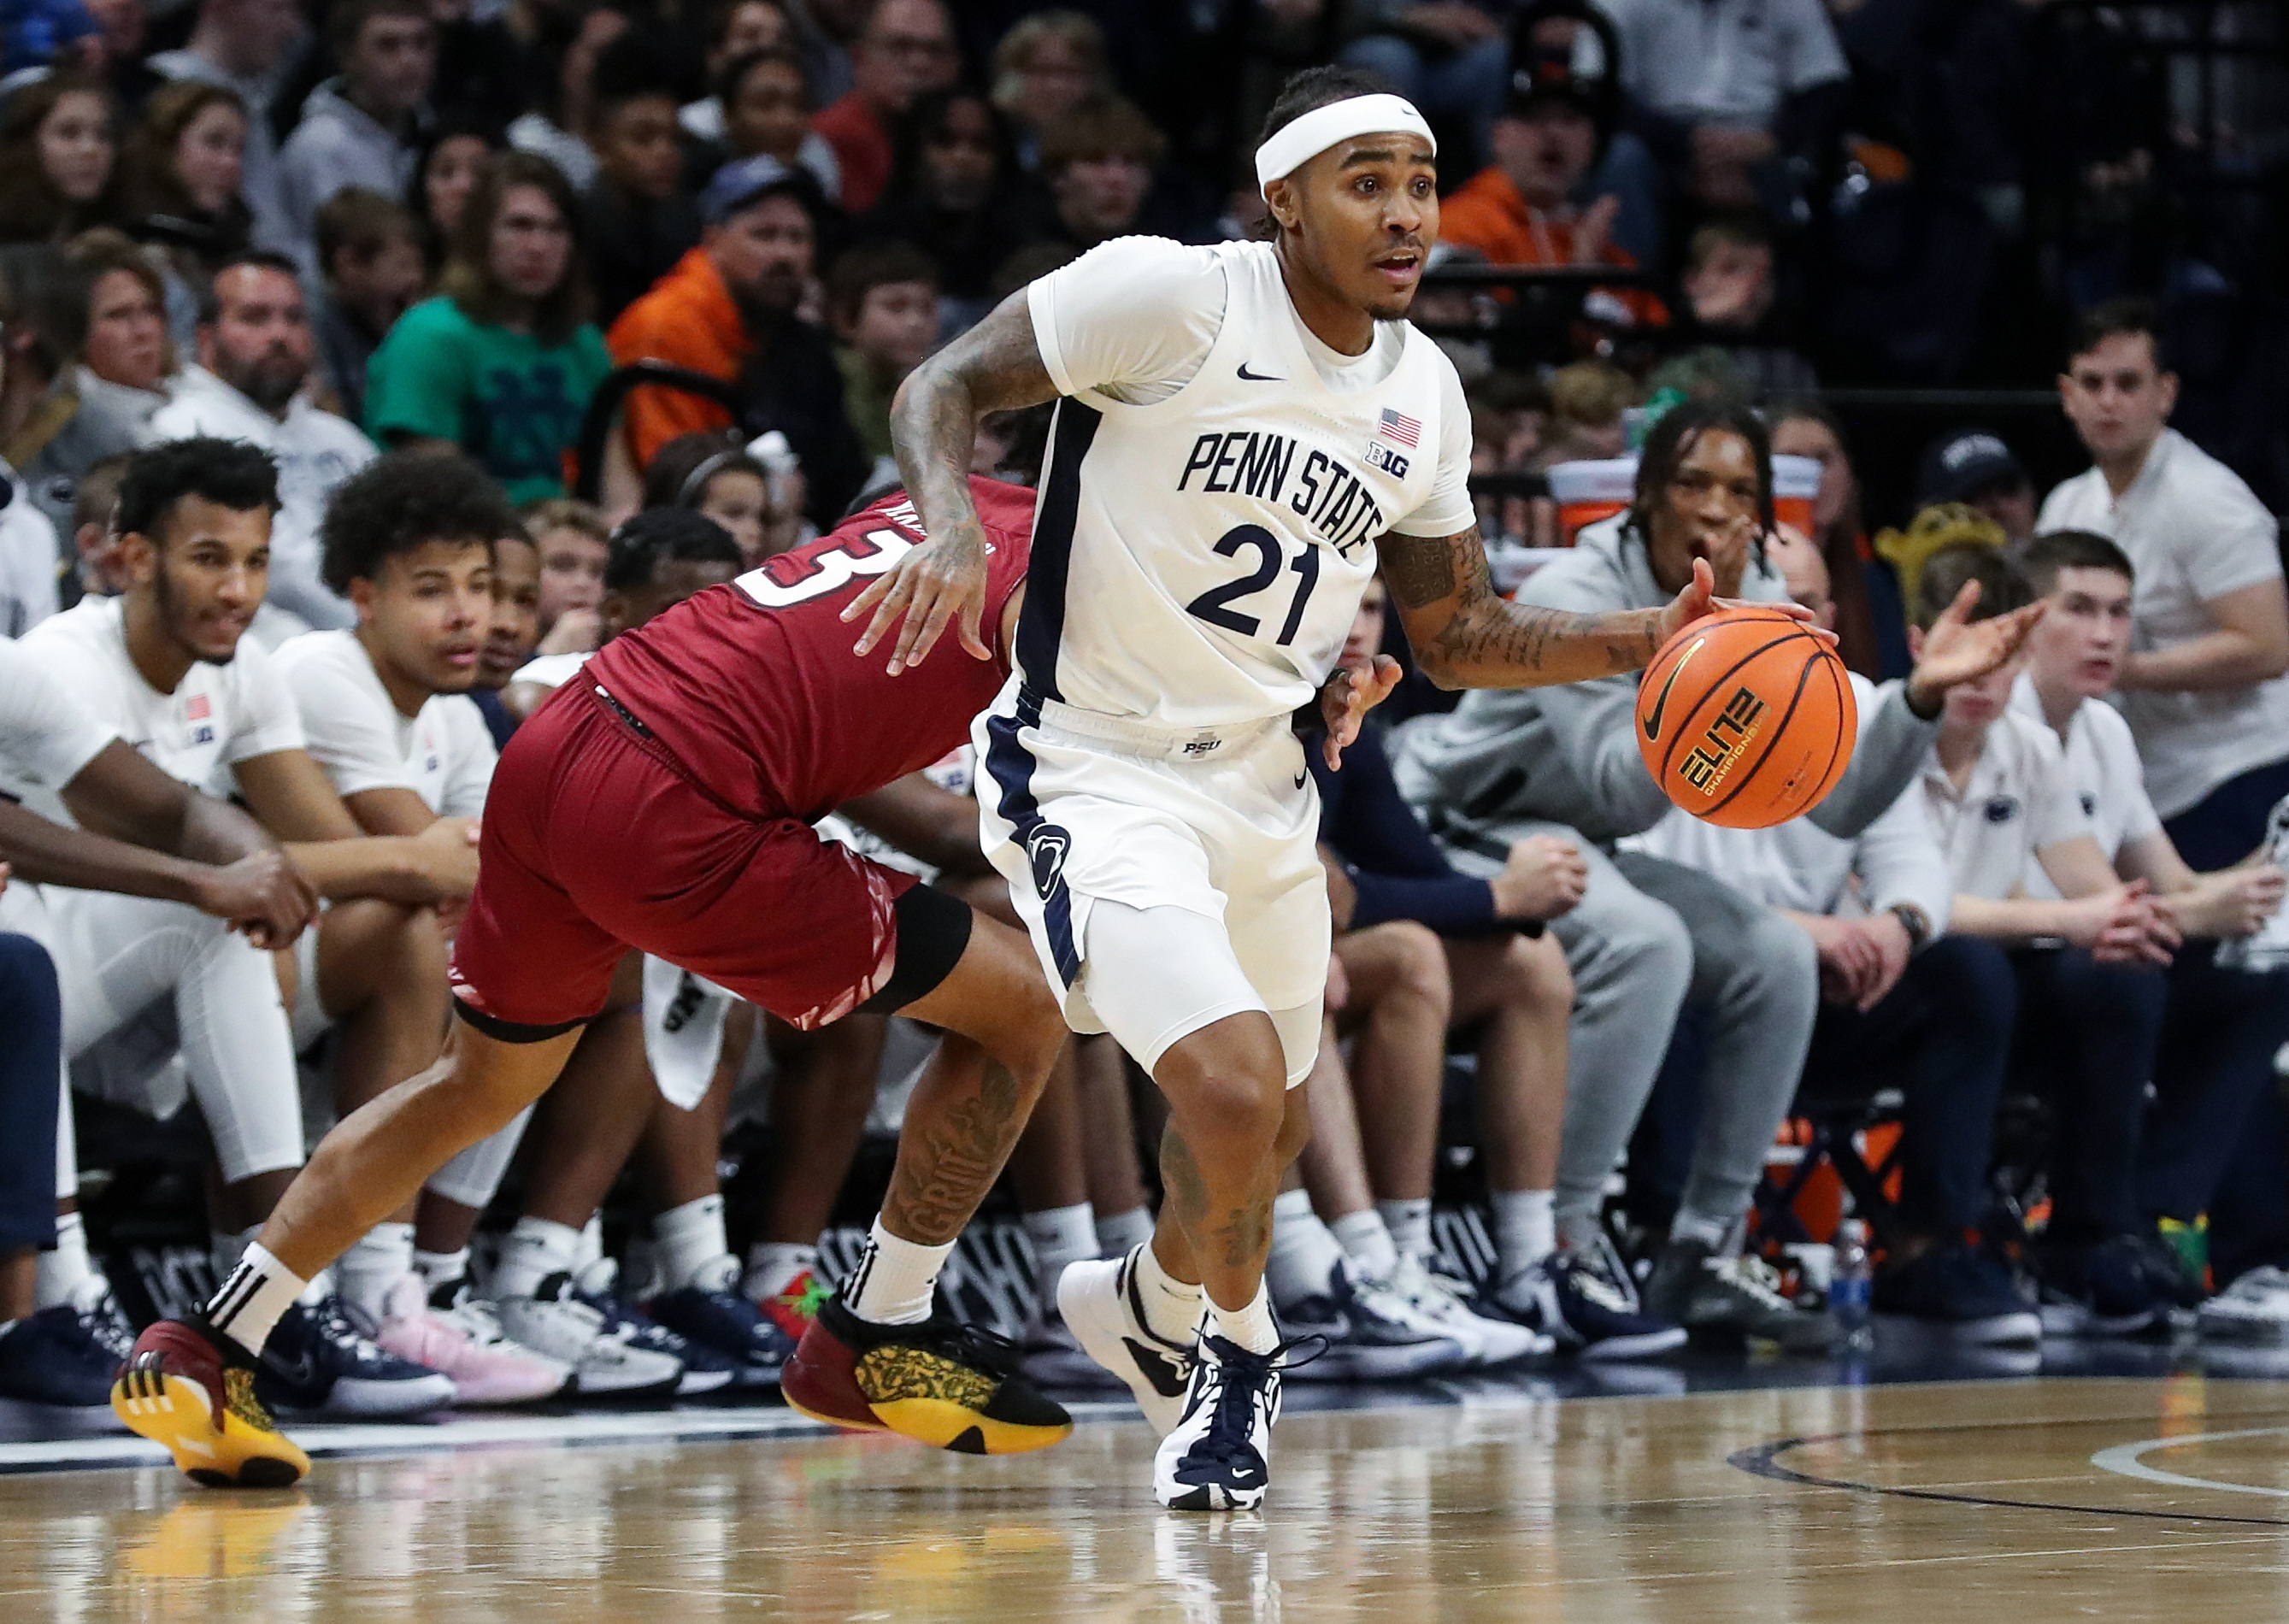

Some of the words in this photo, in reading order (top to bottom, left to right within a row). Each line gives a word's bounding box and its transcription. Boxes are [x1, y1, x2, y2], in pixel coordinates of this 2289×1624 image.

[1176, 431, 1297, 503] PENN
[1291, 449, 1383, 559] STATE
[731, 527, 916, 609] 3
[1184, 523, 1321, 646] 21
[1181, 738, 1222, 755] PSU
[1678, 685, 1766, 791] ELITE
